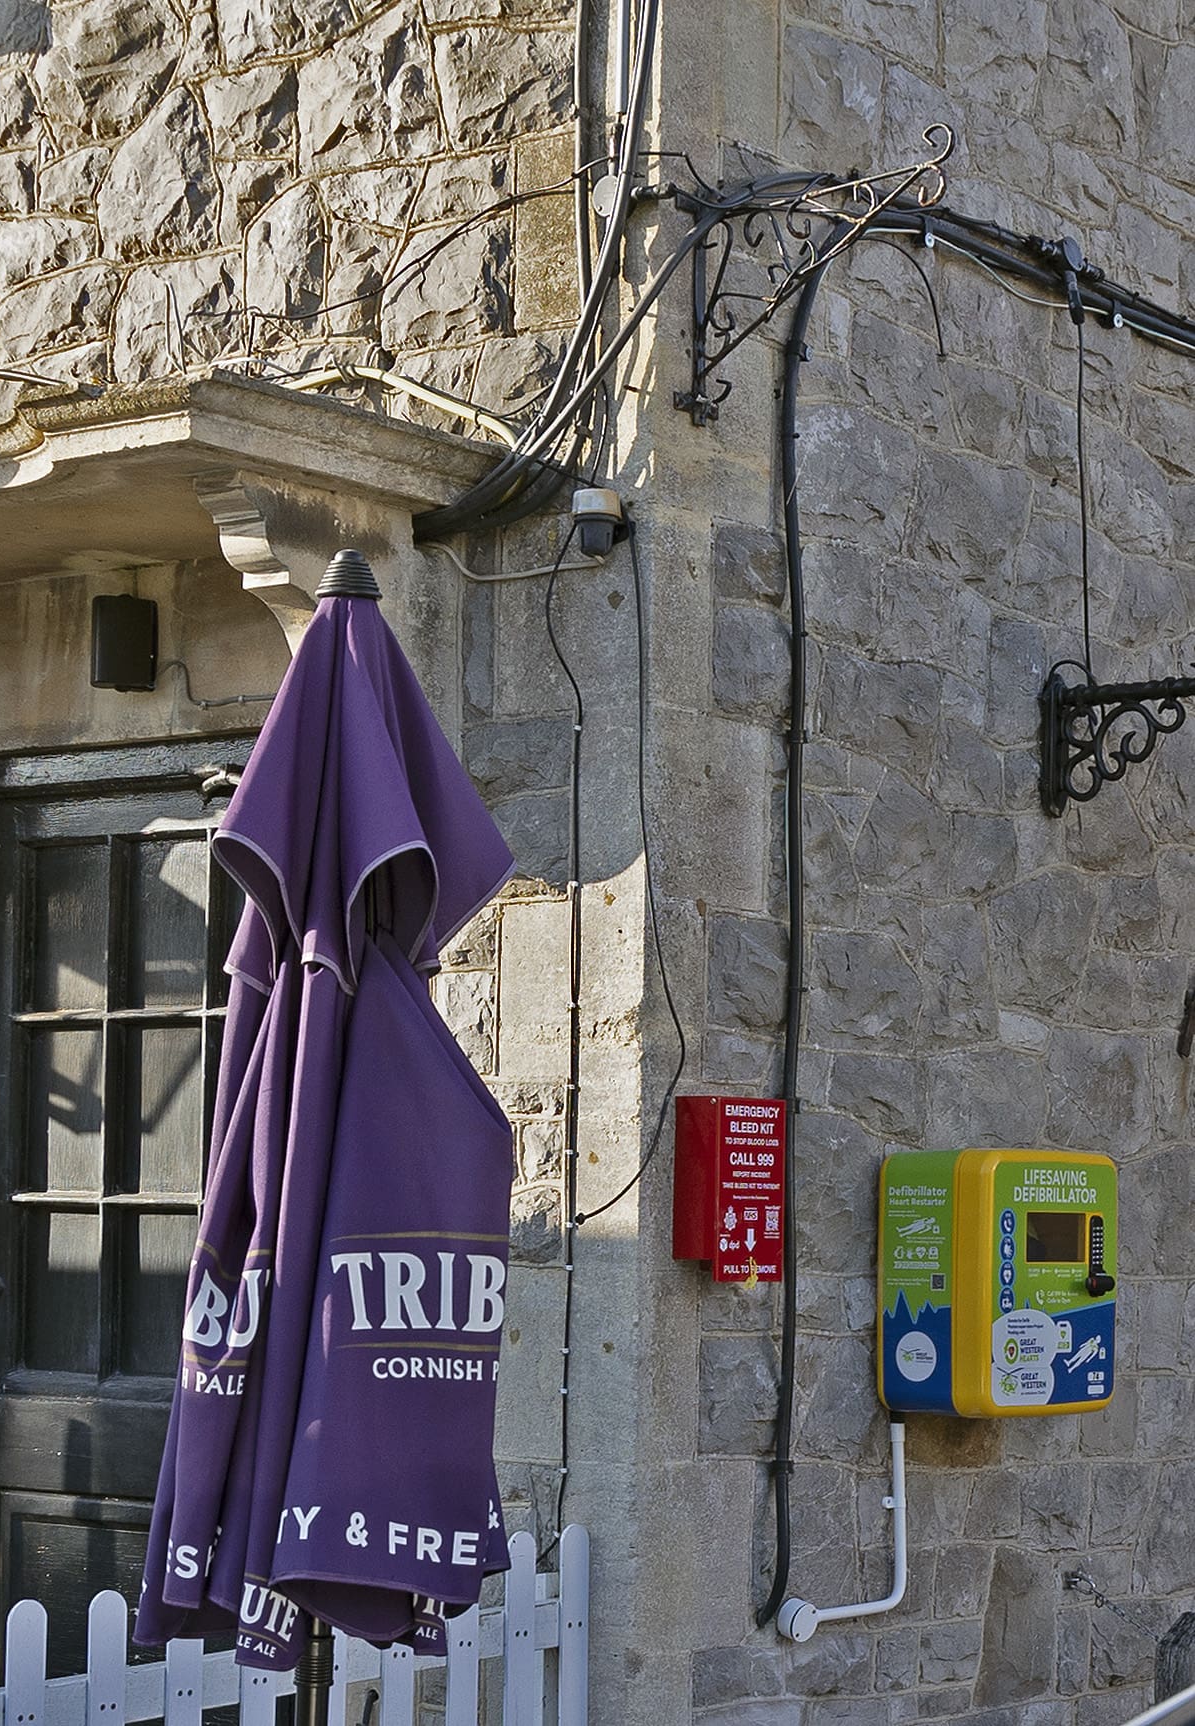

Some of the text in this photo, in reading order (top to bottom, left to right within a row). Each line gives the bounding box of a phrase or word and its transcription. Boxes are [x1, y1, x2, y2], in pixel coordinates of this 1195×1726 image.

[725, 1104, 780, 1119] EMERGENCY
[730, 1121, 775, 1135] BLEED KIT
[725, 1137, 779, 1147] TO STOP BLOOD LOSS
[729, 1152, 774, 1166] CALL 999
[1023, 1169, 1087, 1186] LIFESAVING
[888, 1185, 947, 1196] Defibrillator
[1013, 1187, 1097, 1204] DEFIBRILLATOR
[889, 1197, 946, 1206] Heart Restarter
[723, 1264, 740, 1274] PULL
[740, 1265, 750, 1274] TO
[331, 1252, 506, 1333] TRIB
[183, 1259, 270, 1348] BU
[1019, 1338, 1037, 1346] GREAT
[1020, 1346, 1044, 1354] WESTERN
[373, 1357, 483, 1381] CORNISH
[1021, 1372, 1039, 1380] GREAT
[195, 1371, 245, 1395] PALE
[1021, 1381, 1047, 1389] WESTERN
[346, 1511, 368, 1548] &
[388, 1521, 487, 1566] FRE
[415, 1626, 438, 1640] ALE
[253, 1641, 277, 1658] ALE
